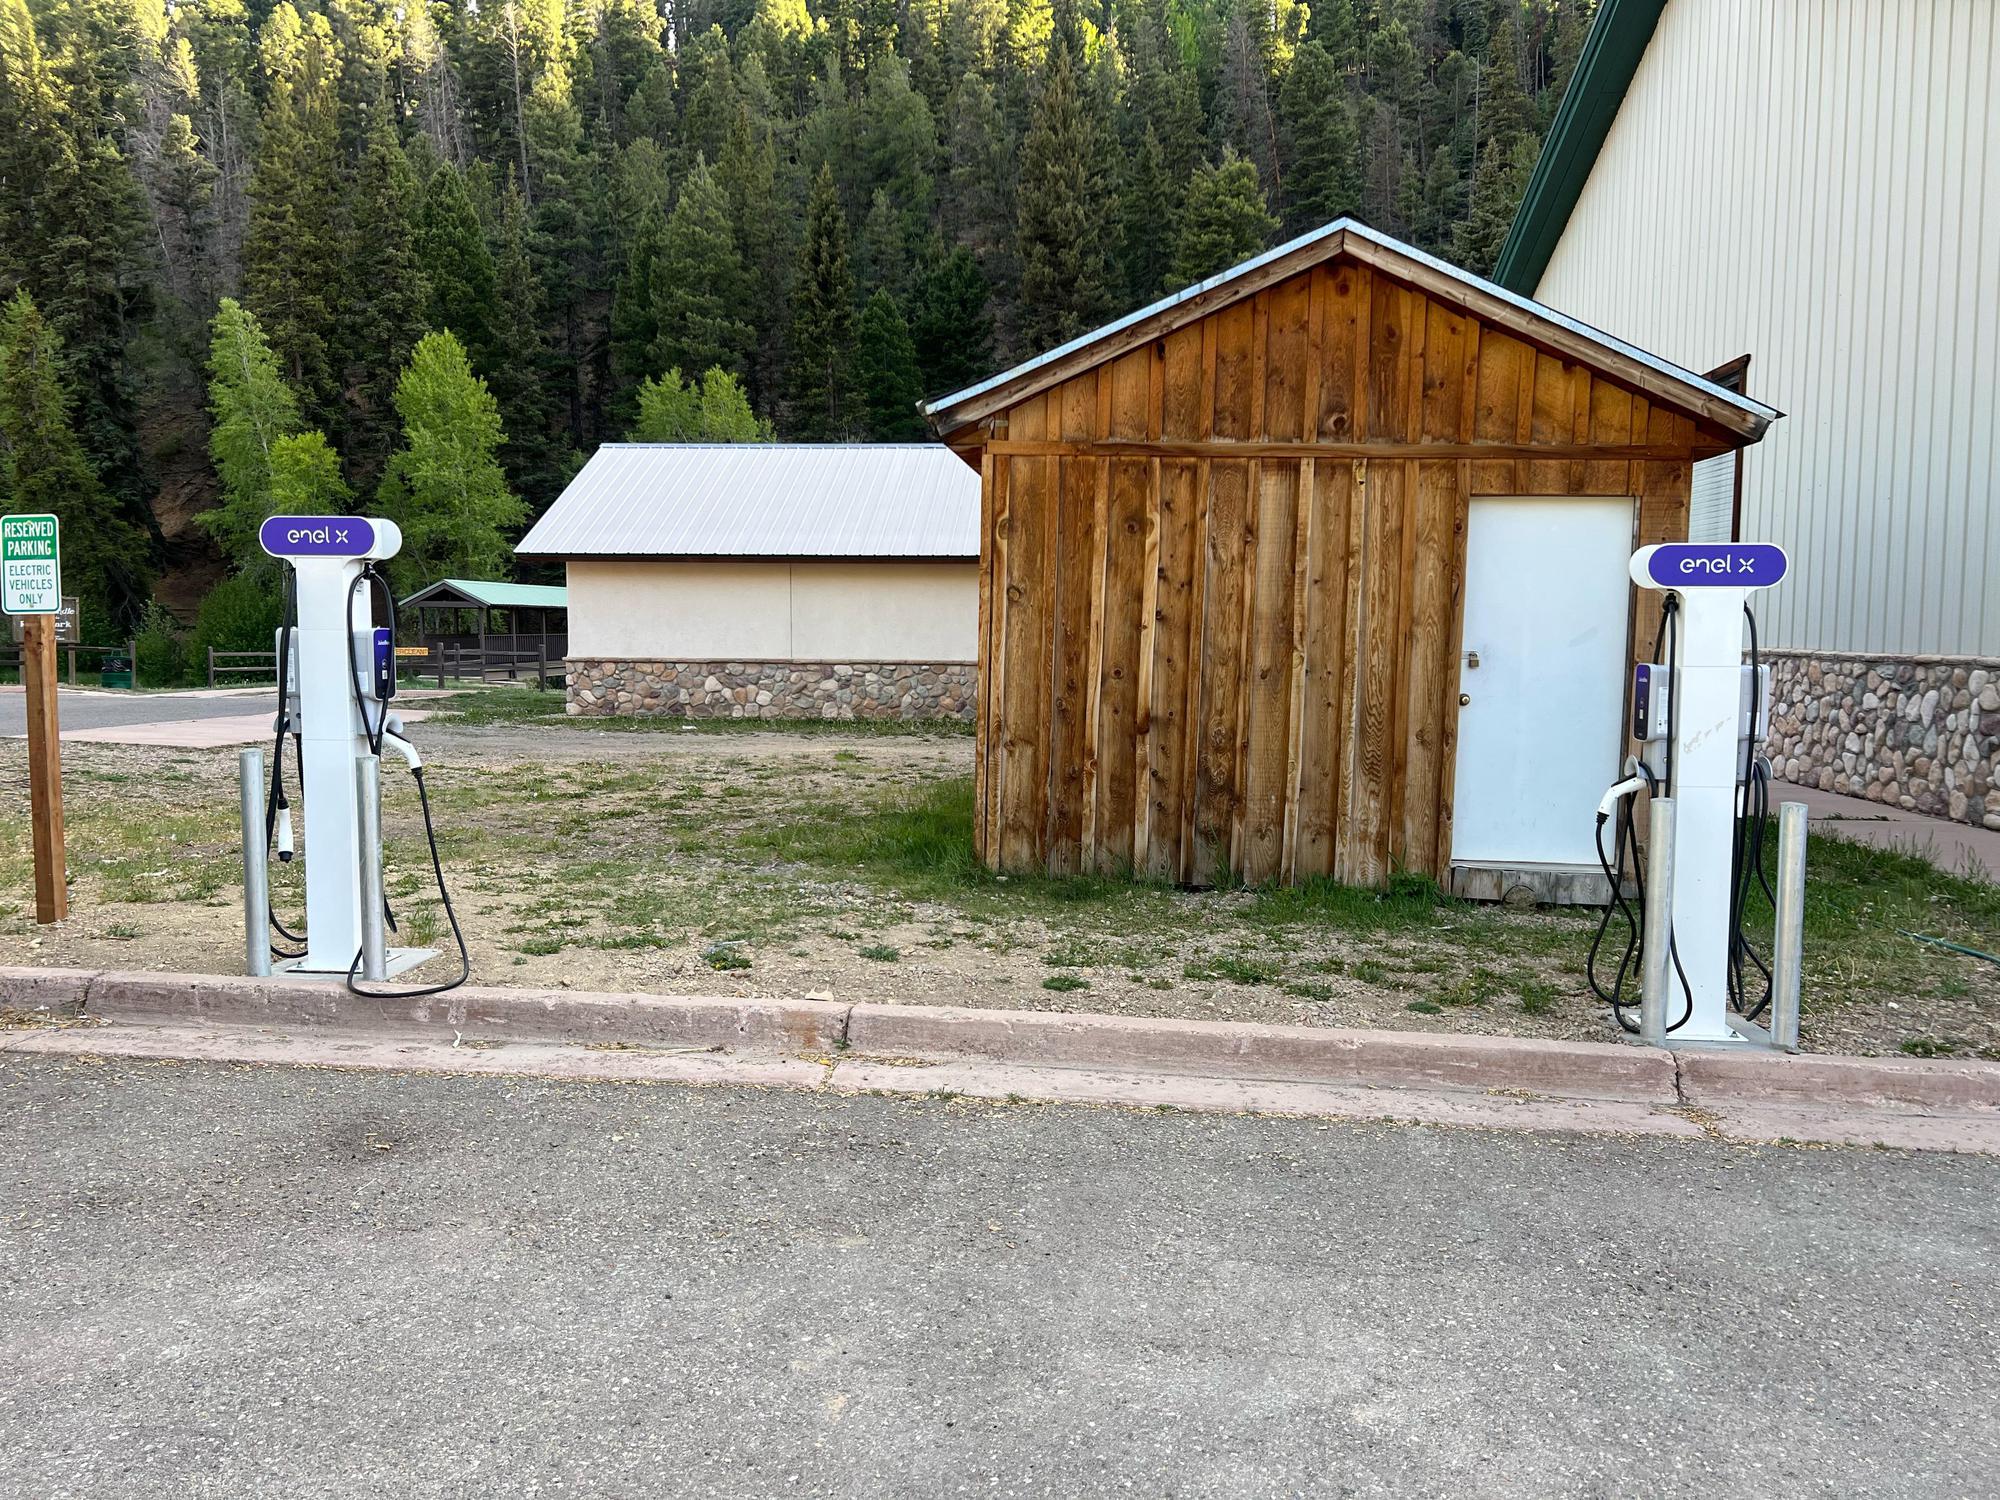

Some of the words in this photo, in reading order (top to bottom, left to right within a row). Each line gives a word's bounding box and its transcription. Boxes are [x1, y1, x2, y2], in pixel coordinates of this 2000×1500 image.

[4, 521, 54, 537] RESERVED
[287, 525, 330, 544] enel
[335, 529, 349, 544] x
[7, 540, 52, 556] PARKING
[9, 565, 51, 576] ELECTRIC
[1679, 554, 1732, 574] enel
[1738, 558, 1755, 574] x
[9, 579, 53, 590] VEHICLES
[19, 593, 43, 605] ONLY
